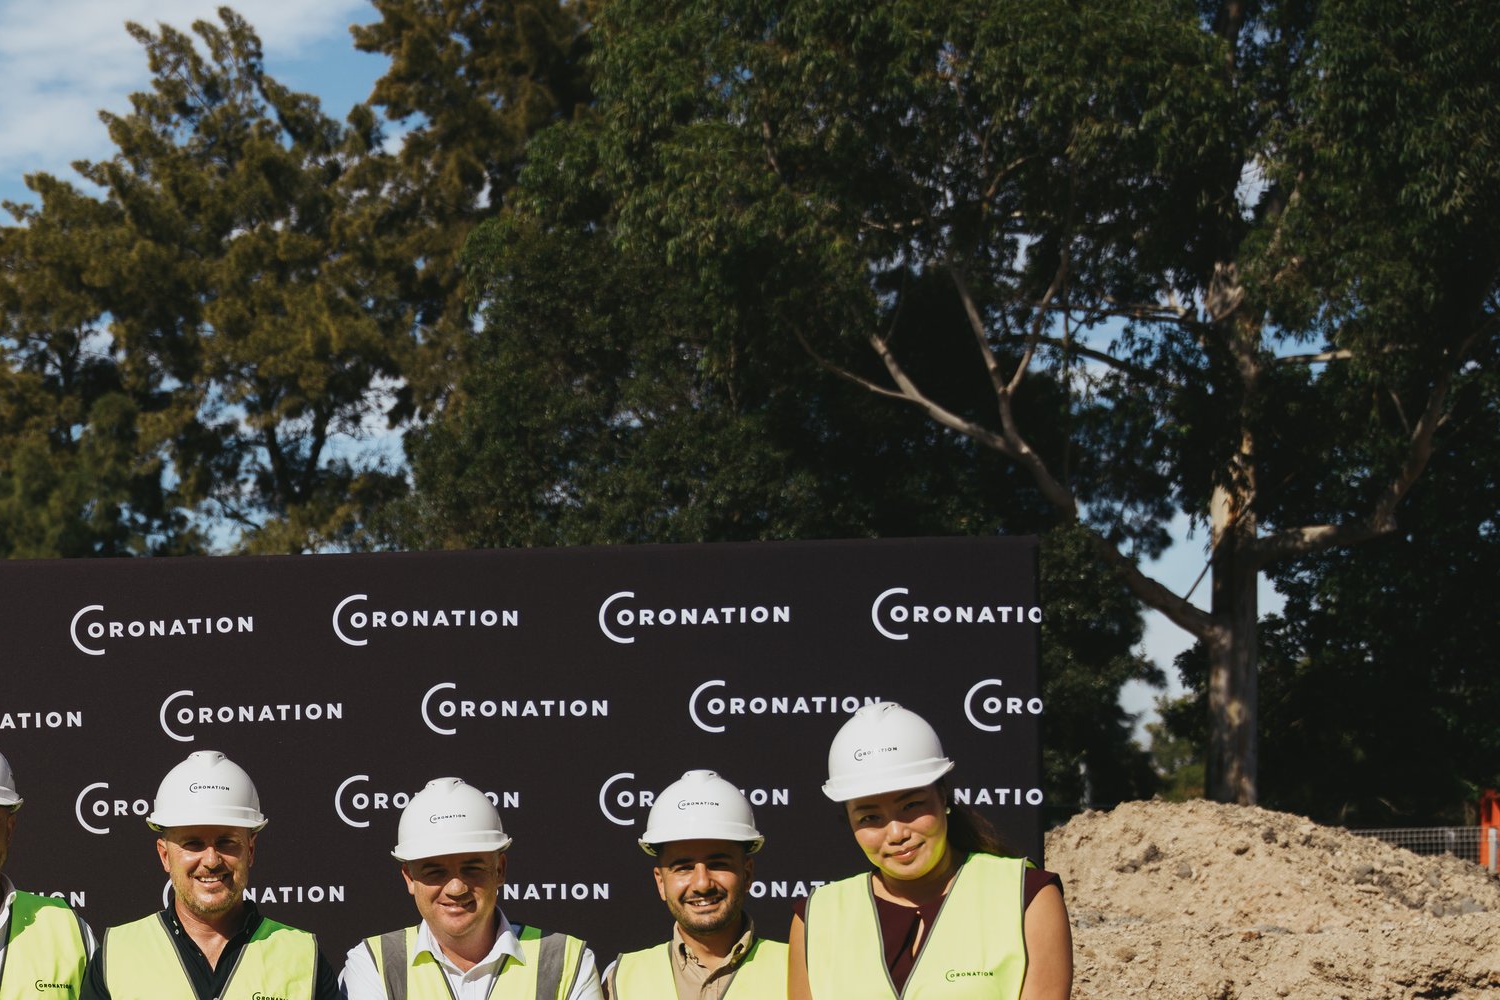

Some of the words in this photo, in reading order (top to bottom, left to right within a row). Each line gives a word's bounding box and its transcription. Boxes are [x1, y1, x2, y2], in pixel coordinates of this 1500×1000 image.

[70, 604, 254, 656] CORONATION
[332, 593, 518, 647] CORONATION
[598, 591, 790, 644] CORONATION
[871, 587, 1042, 640] CORONATIO
[159, 689, 343, 742] CORONATION
[421, 682, 608, 736] CORONATION
[853, 747, 898, 761] COROTION
[953, 788, 1044, 806] NATIO
[242, 884, 345, 905] NATION
[496, 883, 610, 900] NATION
[945, 969, 995, 983] CORONATION
